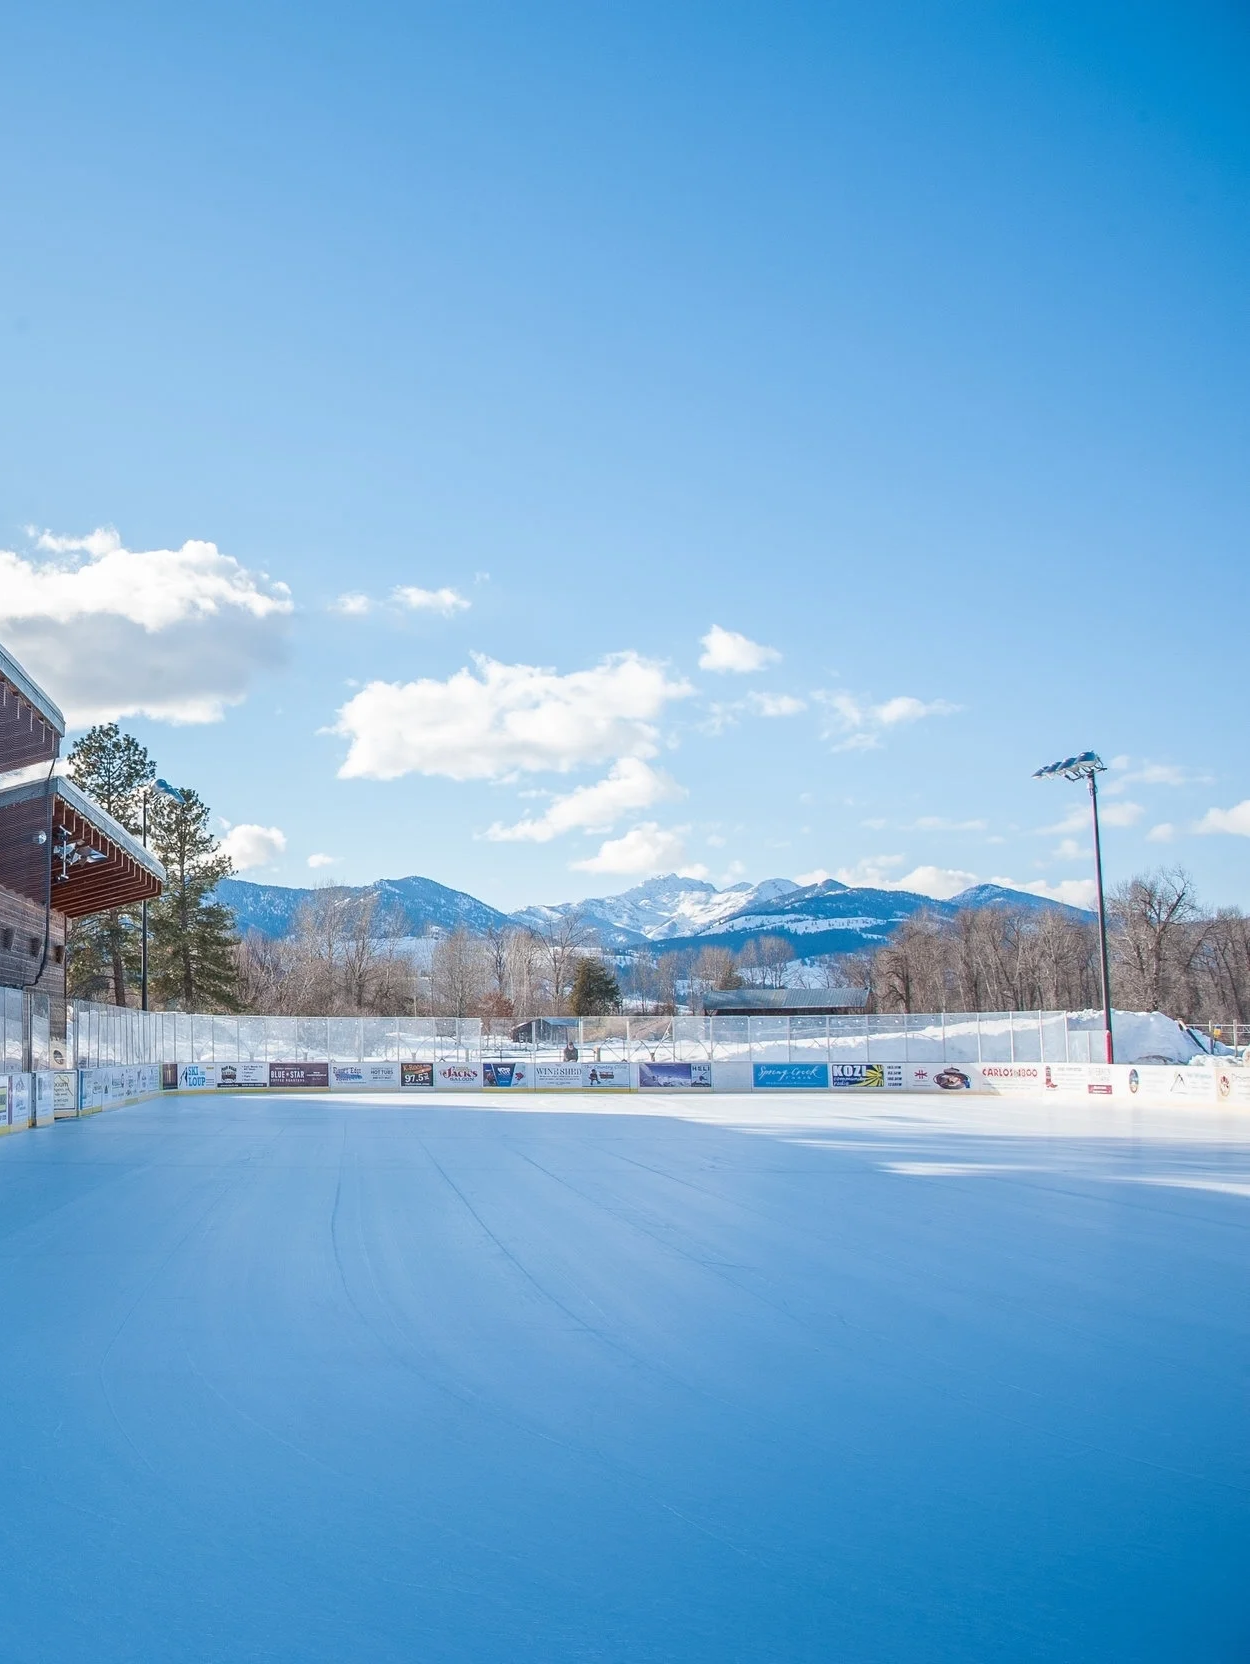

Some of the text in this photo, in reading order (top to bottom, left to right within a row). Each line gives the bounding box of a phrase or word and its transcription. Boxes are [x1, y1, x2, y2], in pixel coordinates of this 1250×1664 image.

[188, 1066, 198, 1075] SKI
[442, 1066, 478, 1079] JACK'S
[758, 1066, 822, 1081] Spring Creek
[833, 1065, 867, 1076] KOZI
[982, 1068, 1012, 1077] CARLOS
[188, 1077, 206, 1086] LOUP
[404, 1073, 424, 1083] 97.5
